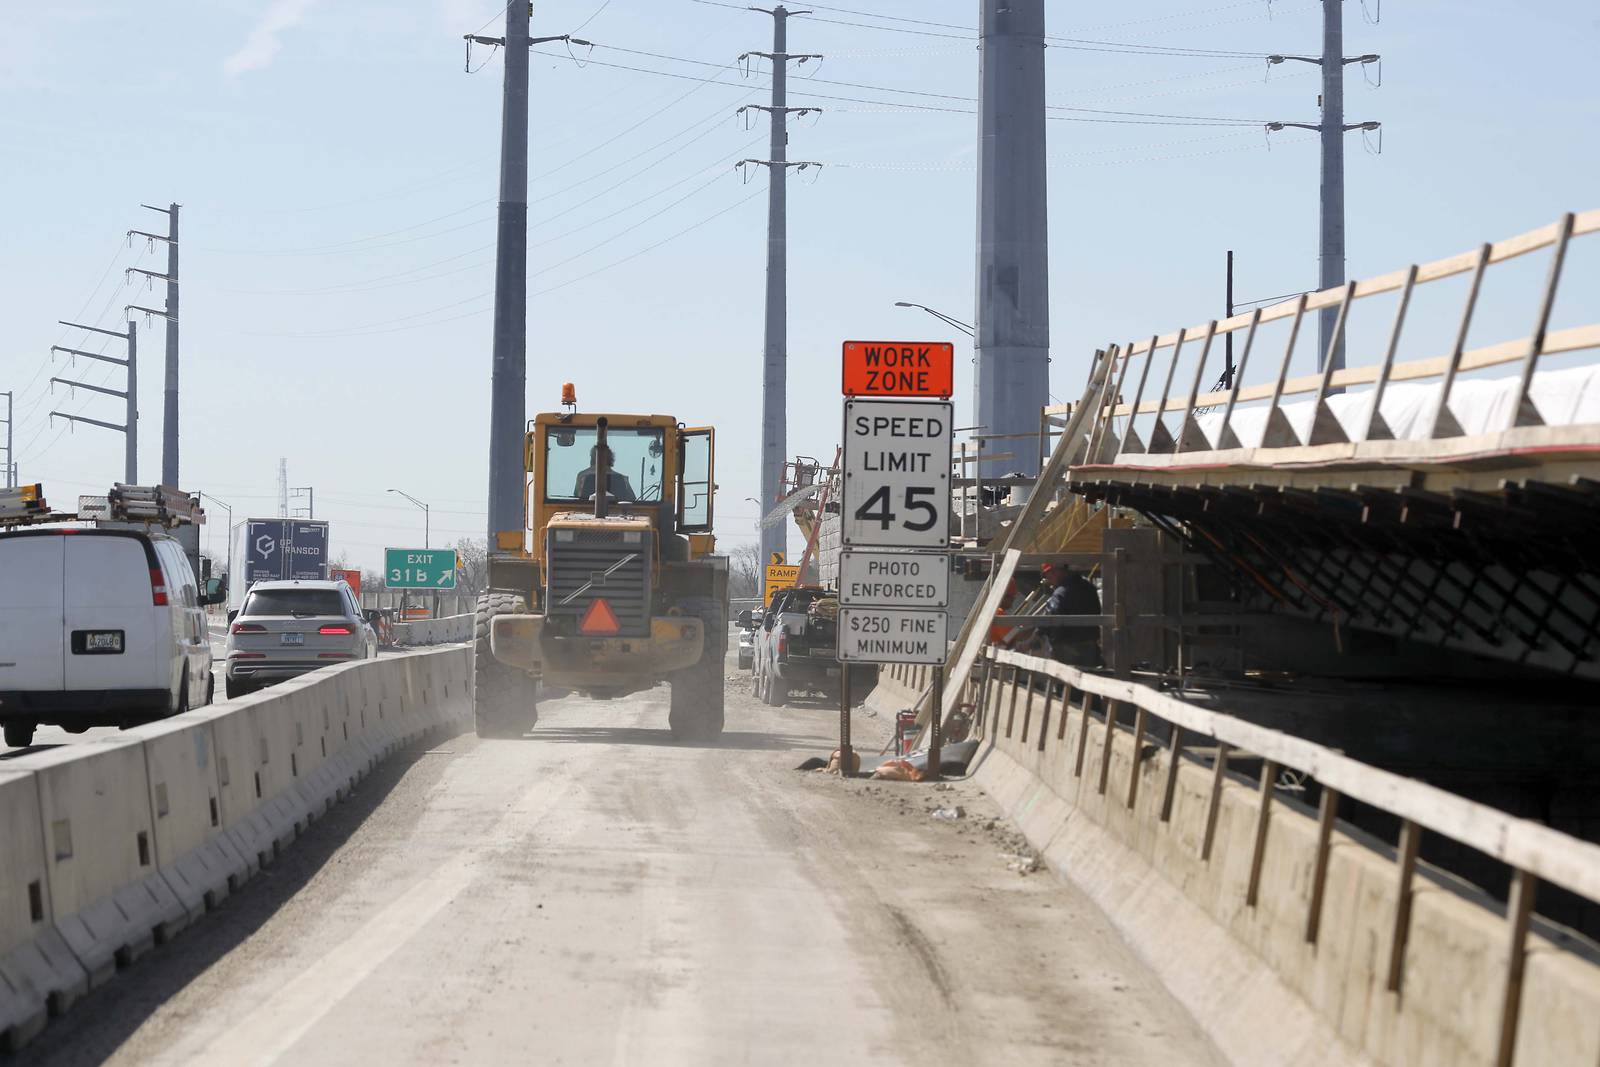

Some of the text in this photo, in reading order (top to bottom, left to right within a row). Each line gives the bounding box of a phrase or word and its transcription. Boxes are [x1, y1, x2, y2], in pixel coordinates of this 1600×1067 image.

[865, 347, 930, 367] WORK
[866, 371, 929, 391] ZONE
[855, 416, 943, 438] SPEED
[864, 451, 931, 472] LIMIT
[855, 486, 938, 532] 45
[407, 554, 433, 564] EXIT
[770, 569, 797, 577] RAMP
[869, 561, 920, 576] PHOTO
[852, 583, 936, 598] ENFORCED
[851, 616, 936, 633] $250 FINE
[858, 639, 928, 655] MINIMUM
